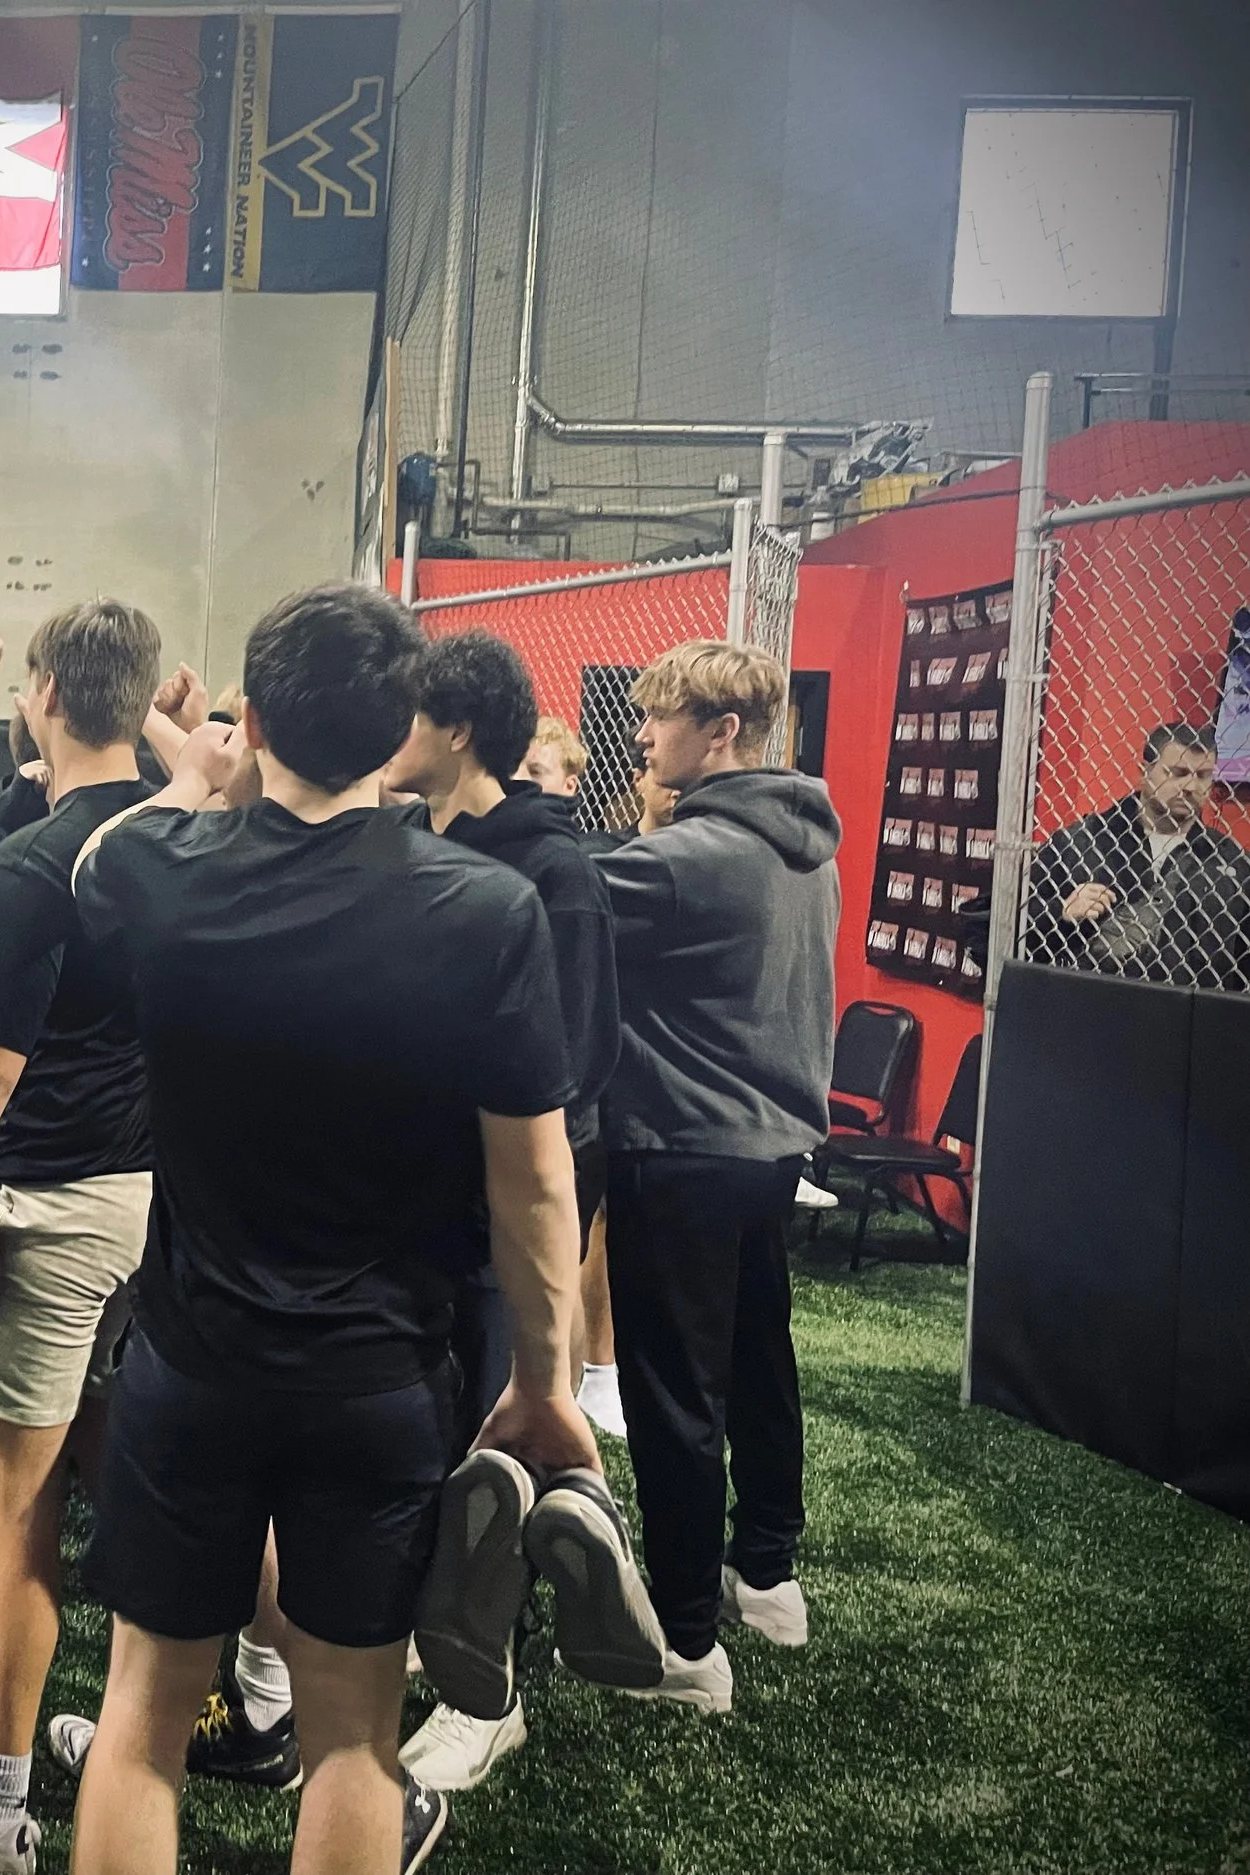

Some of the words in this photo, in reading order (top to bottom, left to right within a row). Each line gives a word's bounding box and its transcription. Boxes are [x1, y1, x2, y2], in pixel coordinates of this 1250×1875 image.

[236, 23, 258, 188] MOUNTAINEER
[101, 125, 204, 274] Miss
[232, 193, 250, 279] NATION
